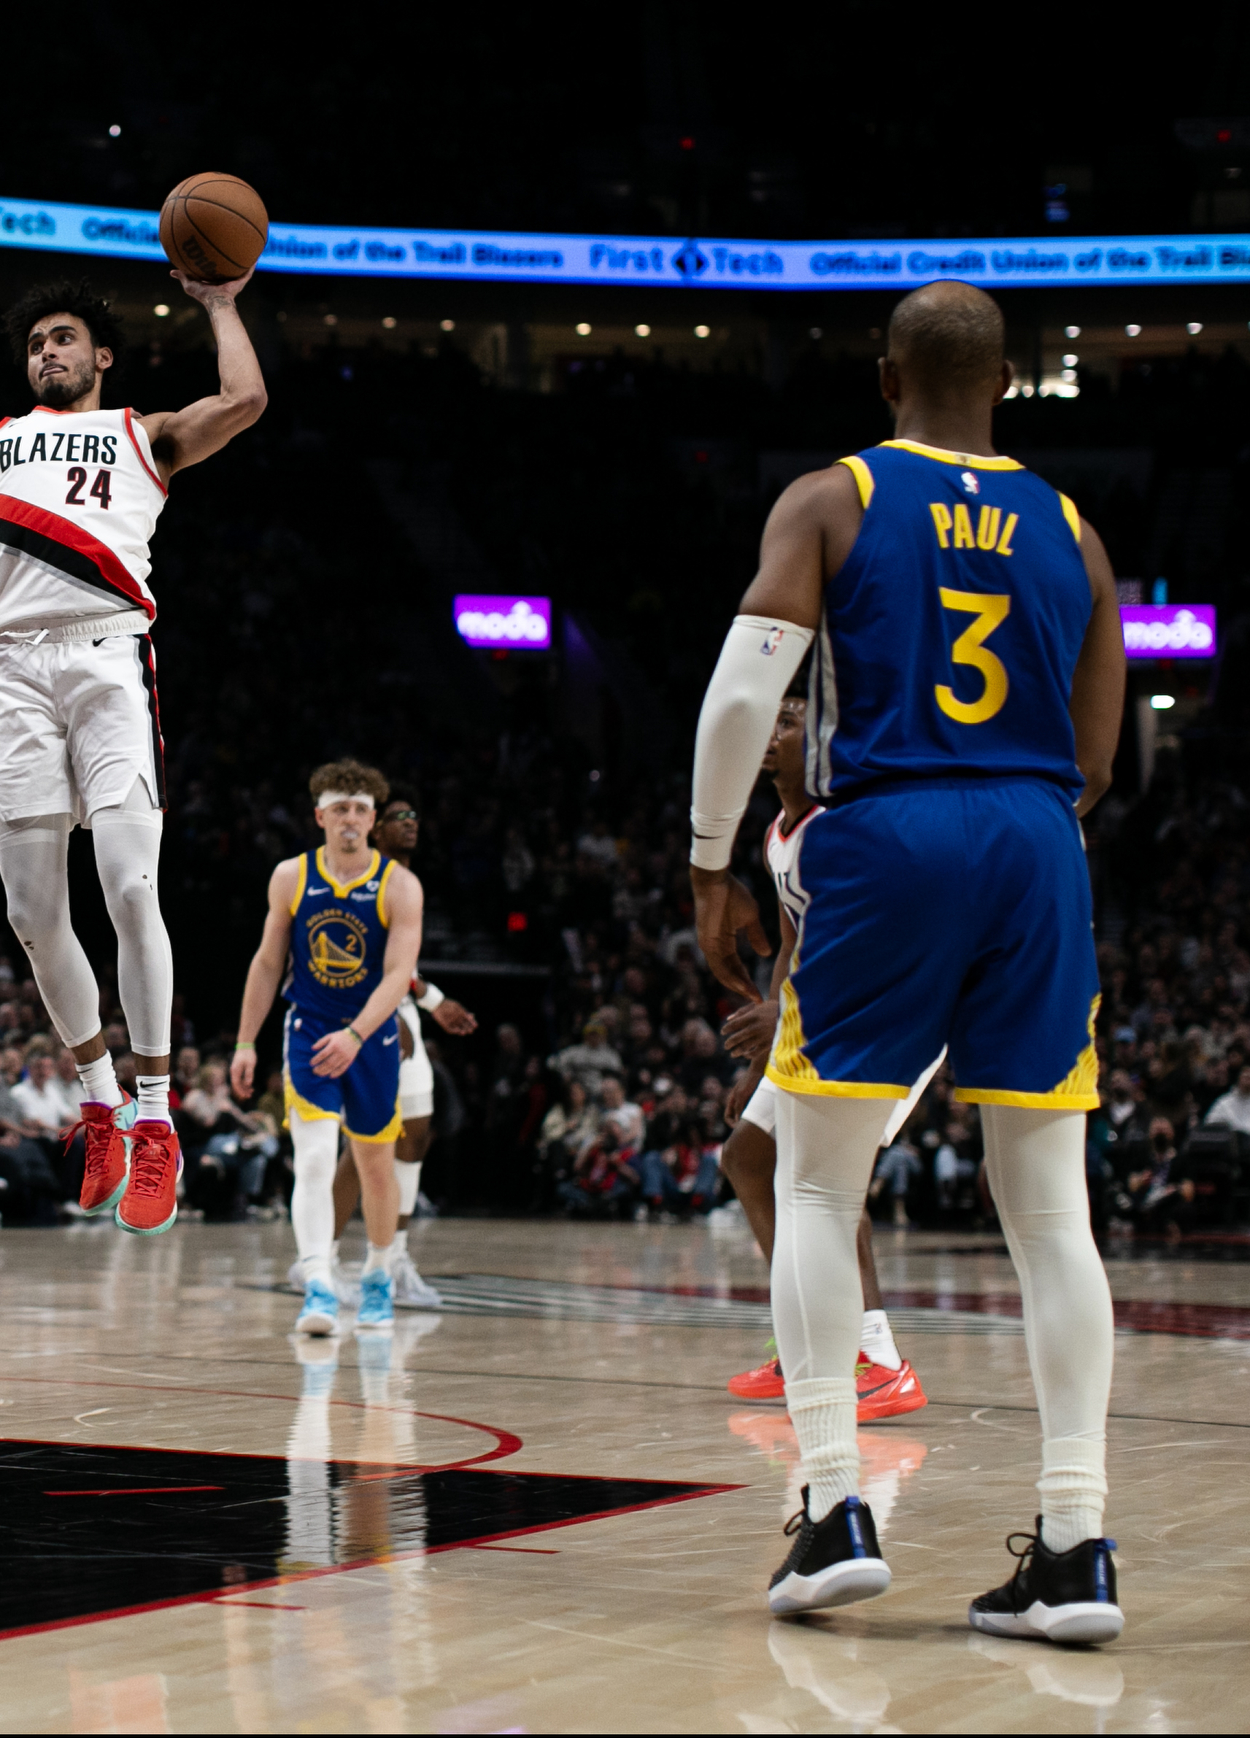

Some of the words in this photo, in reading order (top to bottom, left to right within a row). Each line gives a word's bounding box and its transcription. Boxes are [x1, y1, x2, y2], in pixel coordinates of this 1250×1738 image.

[332, 239, 360, 260] of
[364, 241, 407, 260] the
[412, 241, 467, 264] Trail
[471, 243, 564, 267] Blazers
[590, 244, 663, 272] First
[713, 247, 784, 275] Tech
[809, 251, 902, 276] Official
[906, 250, 986, 273] Credit
[991, 248, 1069, 272] Union
[1073, 247, 1102, 272] of
[1106, 247, 1152, 271] the
[1153, 244, 1214, 271] Trail
[65, 466, 112, 511] 24
[929, 502, 1019, 556] PAUL
[934, 586, 1011, 724] 3
[306, 908, 343, 928] GOLDEN
[345, 912, 368, 934] STATE
[345, 934, 357, 952] 2
[308, 960, 368, 988] WARRIORS
